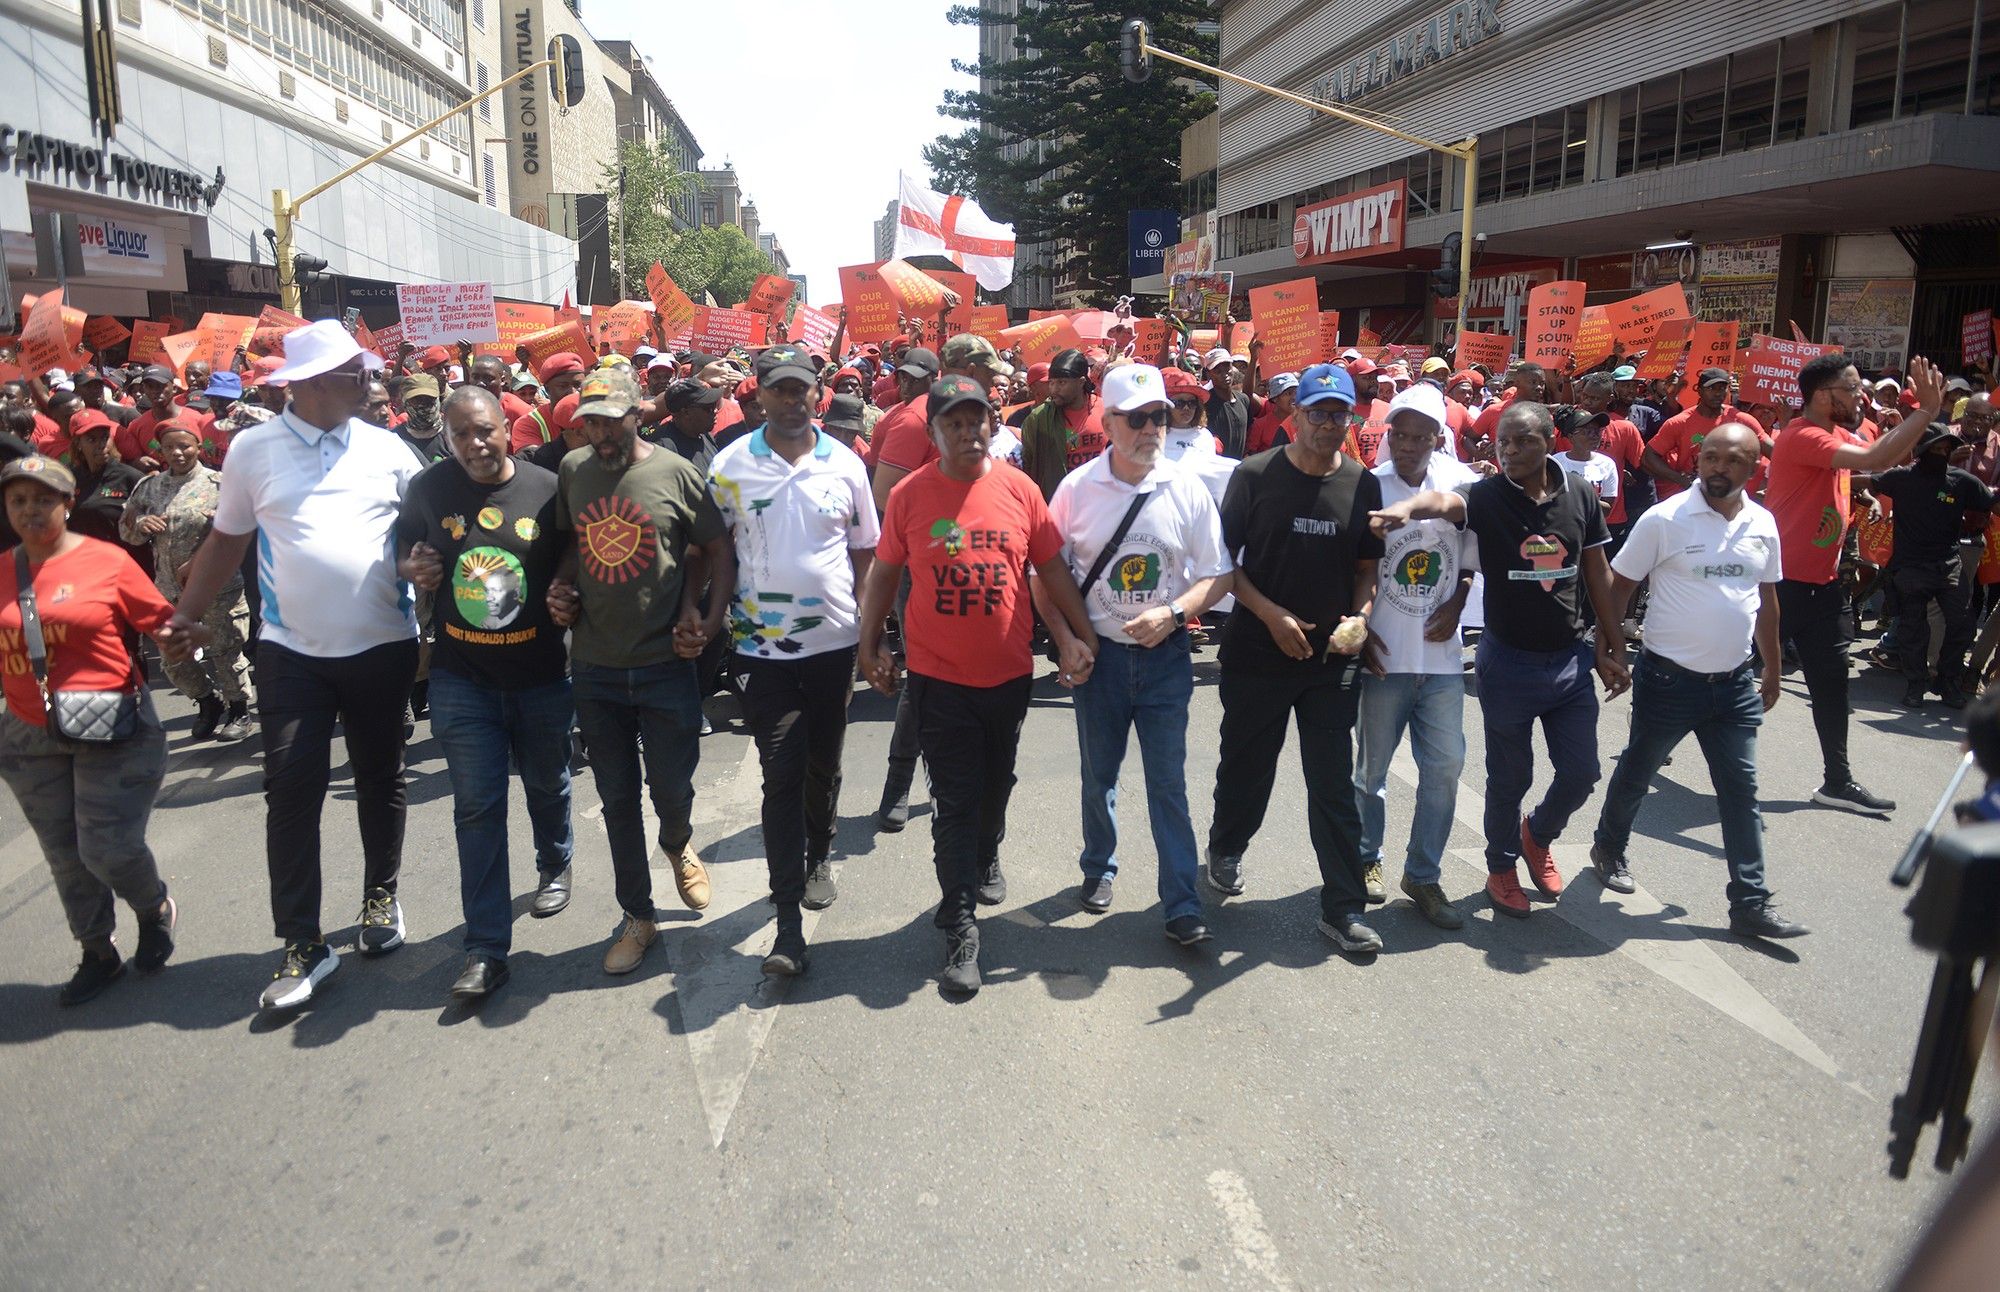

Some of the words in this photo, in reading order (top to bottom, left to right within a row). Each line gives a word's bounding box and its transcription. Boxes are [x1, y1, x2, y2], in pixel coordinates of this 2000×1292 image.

[515, 8, 535, 92] MUTUAL
[520, 97, 536, 126] ON
[522, 131, 539, 175] ONE
[114, 154, 204, 199] TOWERS
[1310, 190, 1396, 256] WIMPY
[79, 224, 104, 246] ave
[105, 221, 148, 257] Liquor
[1135, 249, 1165, 258] LIBERT
[360, 288, 396, 296] CLICK
[460, 284, 485, 293] MUST
[1467, 273, 1530, 308] WIMPY
[860, 292, 881, 300] OUR
[855, 302, 890, 312] PEOPLE
[1275, 304, 1310, 317] CANNOT
[1539, 306, 1575, 316] STAND
[710, 309, 738, 318] REVERSE
[740, 311, 752, 319] THE
[861, 314, 887, 323] SLEEP
[1633, 317, 1649, 326] ARE
[1651, 308, 1676, 320] TIRED
[497, 321, 546, 330] MAPHOSA
[927, 320, 961, 331] SOTH
[1271, 318, 1293, 327] HAVE
[1550, 320, 1565, 328] UP
[1580, 319, 1609, 327] LOYMEN
[722, 324, 751, 333] INCREASE
[855, 323, 896, 334] HUNGRY
[1267, 322, 1308, 336] PRESIDENT
[1643, 325, 1655, 334] OF
[499, 332, 516, 340] UST
[693, 334, 725, 343] SPENDING
[707, 329, 750, 339] GOVERNMENT
[1281, 330, 1317, 342] PRESIDES
[1537, 333, 1572, 343] SOUTH
[378, 335, 400, 346] LIVING
[698, 341, 718, 349] AREAS
[1628, 337, 1654, 346] CORRU
[1656, 341, 1684, 349] RAMA
[1275, 345, 1296, 353] OVER
[1466, 341, 1504, 351] RAMAPHOSA
[1573, 341, 1607, 351] OLERATED
[1711, 342, 1731, 351] GBV
[1767, 341, 1794, 353] JOBS
[1796, 345, 1821, 356] FOR
[1268, 348, 1311, 363] COLLAPSED
[1536, 347, 1570, 357] AFRICA
[1657, 352, 1680, 361] MUST
[1702, 356, 1713, 365] IS
[1780, 356, 1801, 367] THE
[1752, 364, 1799, 379] UNEMPL
[1756, 379, 1770, 388] AT
[1772, 381, 1780, 390] A
[1783, 383, 1801, 393] LIV
[1769, 393, 1803, 406] WGE
[1293, 517, 1336, 536] SHUTDOWN
[970, 530, 1009, 549] EFF
[601, 551, 624, 559] LAND
[932, 562, 1008, 587] VOTE
[1704, 563, 1744, 579] F4SD
[1399, 584, 1437, 597] ARETA
[935, 588, 1004, 616] EFF
[1111, 590, 1160, 604] ARETA
[465, 630, 505, 645] MANGALISO
